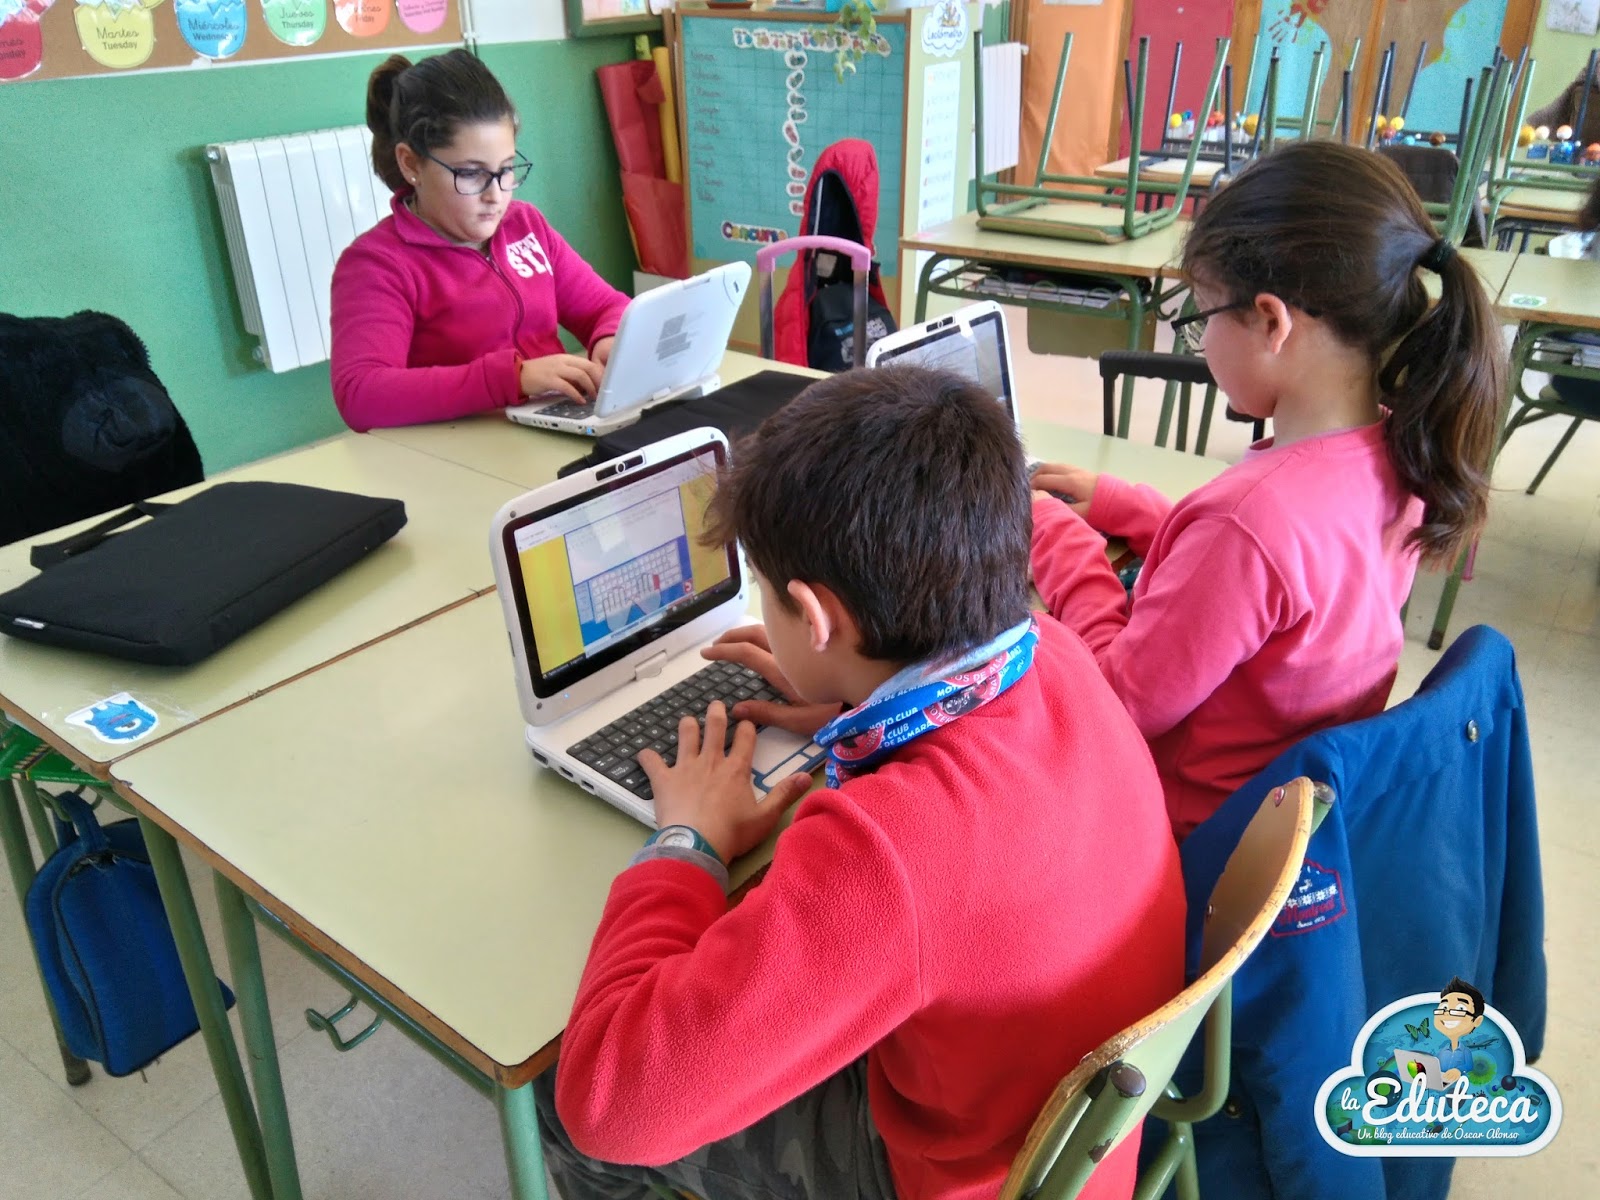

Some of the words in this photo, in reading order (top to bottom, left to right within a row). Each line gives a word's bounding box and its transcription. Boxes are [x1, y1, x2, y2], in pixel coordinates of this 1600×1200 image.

[188, 18, 240, 31] Miércoles
[282, 21, 314, 29] Thursday
[96, 27, 139, 39] Martes
[193, 32, 238, 41] Wednesy
[102, 41, 138, 50] Tuesday
[895, 707, 919, 722] CLUB
[887, 723, 910, 739] CLUB
[897, 720, 932, 743] ALMARA
